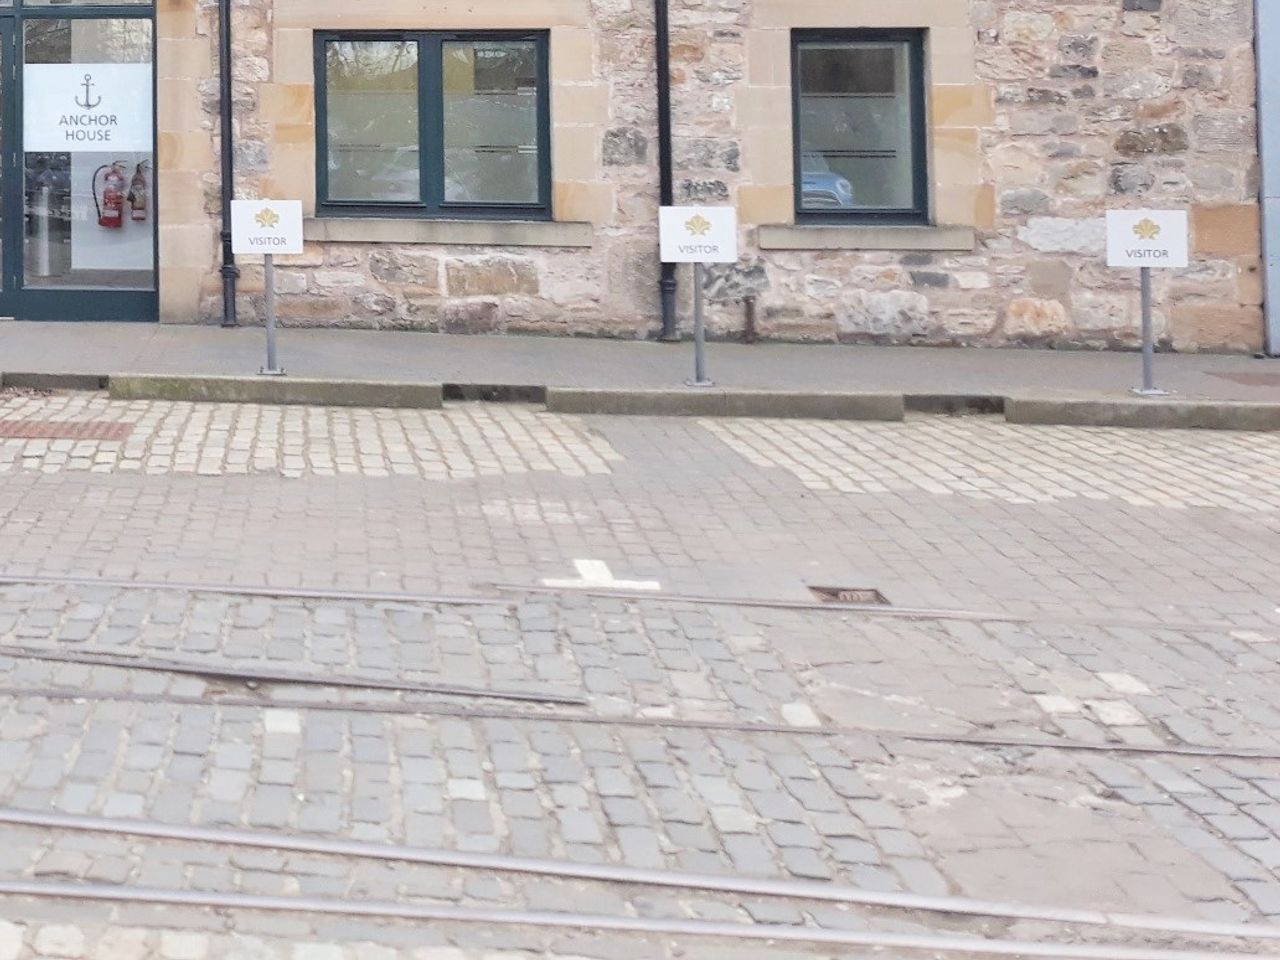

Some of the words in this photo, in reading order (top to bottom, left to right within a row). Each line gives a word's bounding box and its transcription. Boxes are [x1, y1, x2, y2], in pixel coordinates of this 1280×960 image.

[59, 114, 118, 127] ANCHOR
[65, 129, 112, 142] HOUSE
[248, 236, 287, 246] VISITOR
[678, 244, 720, 254] VISITOR
[1125, 249, 1169, 258] VISITOR
